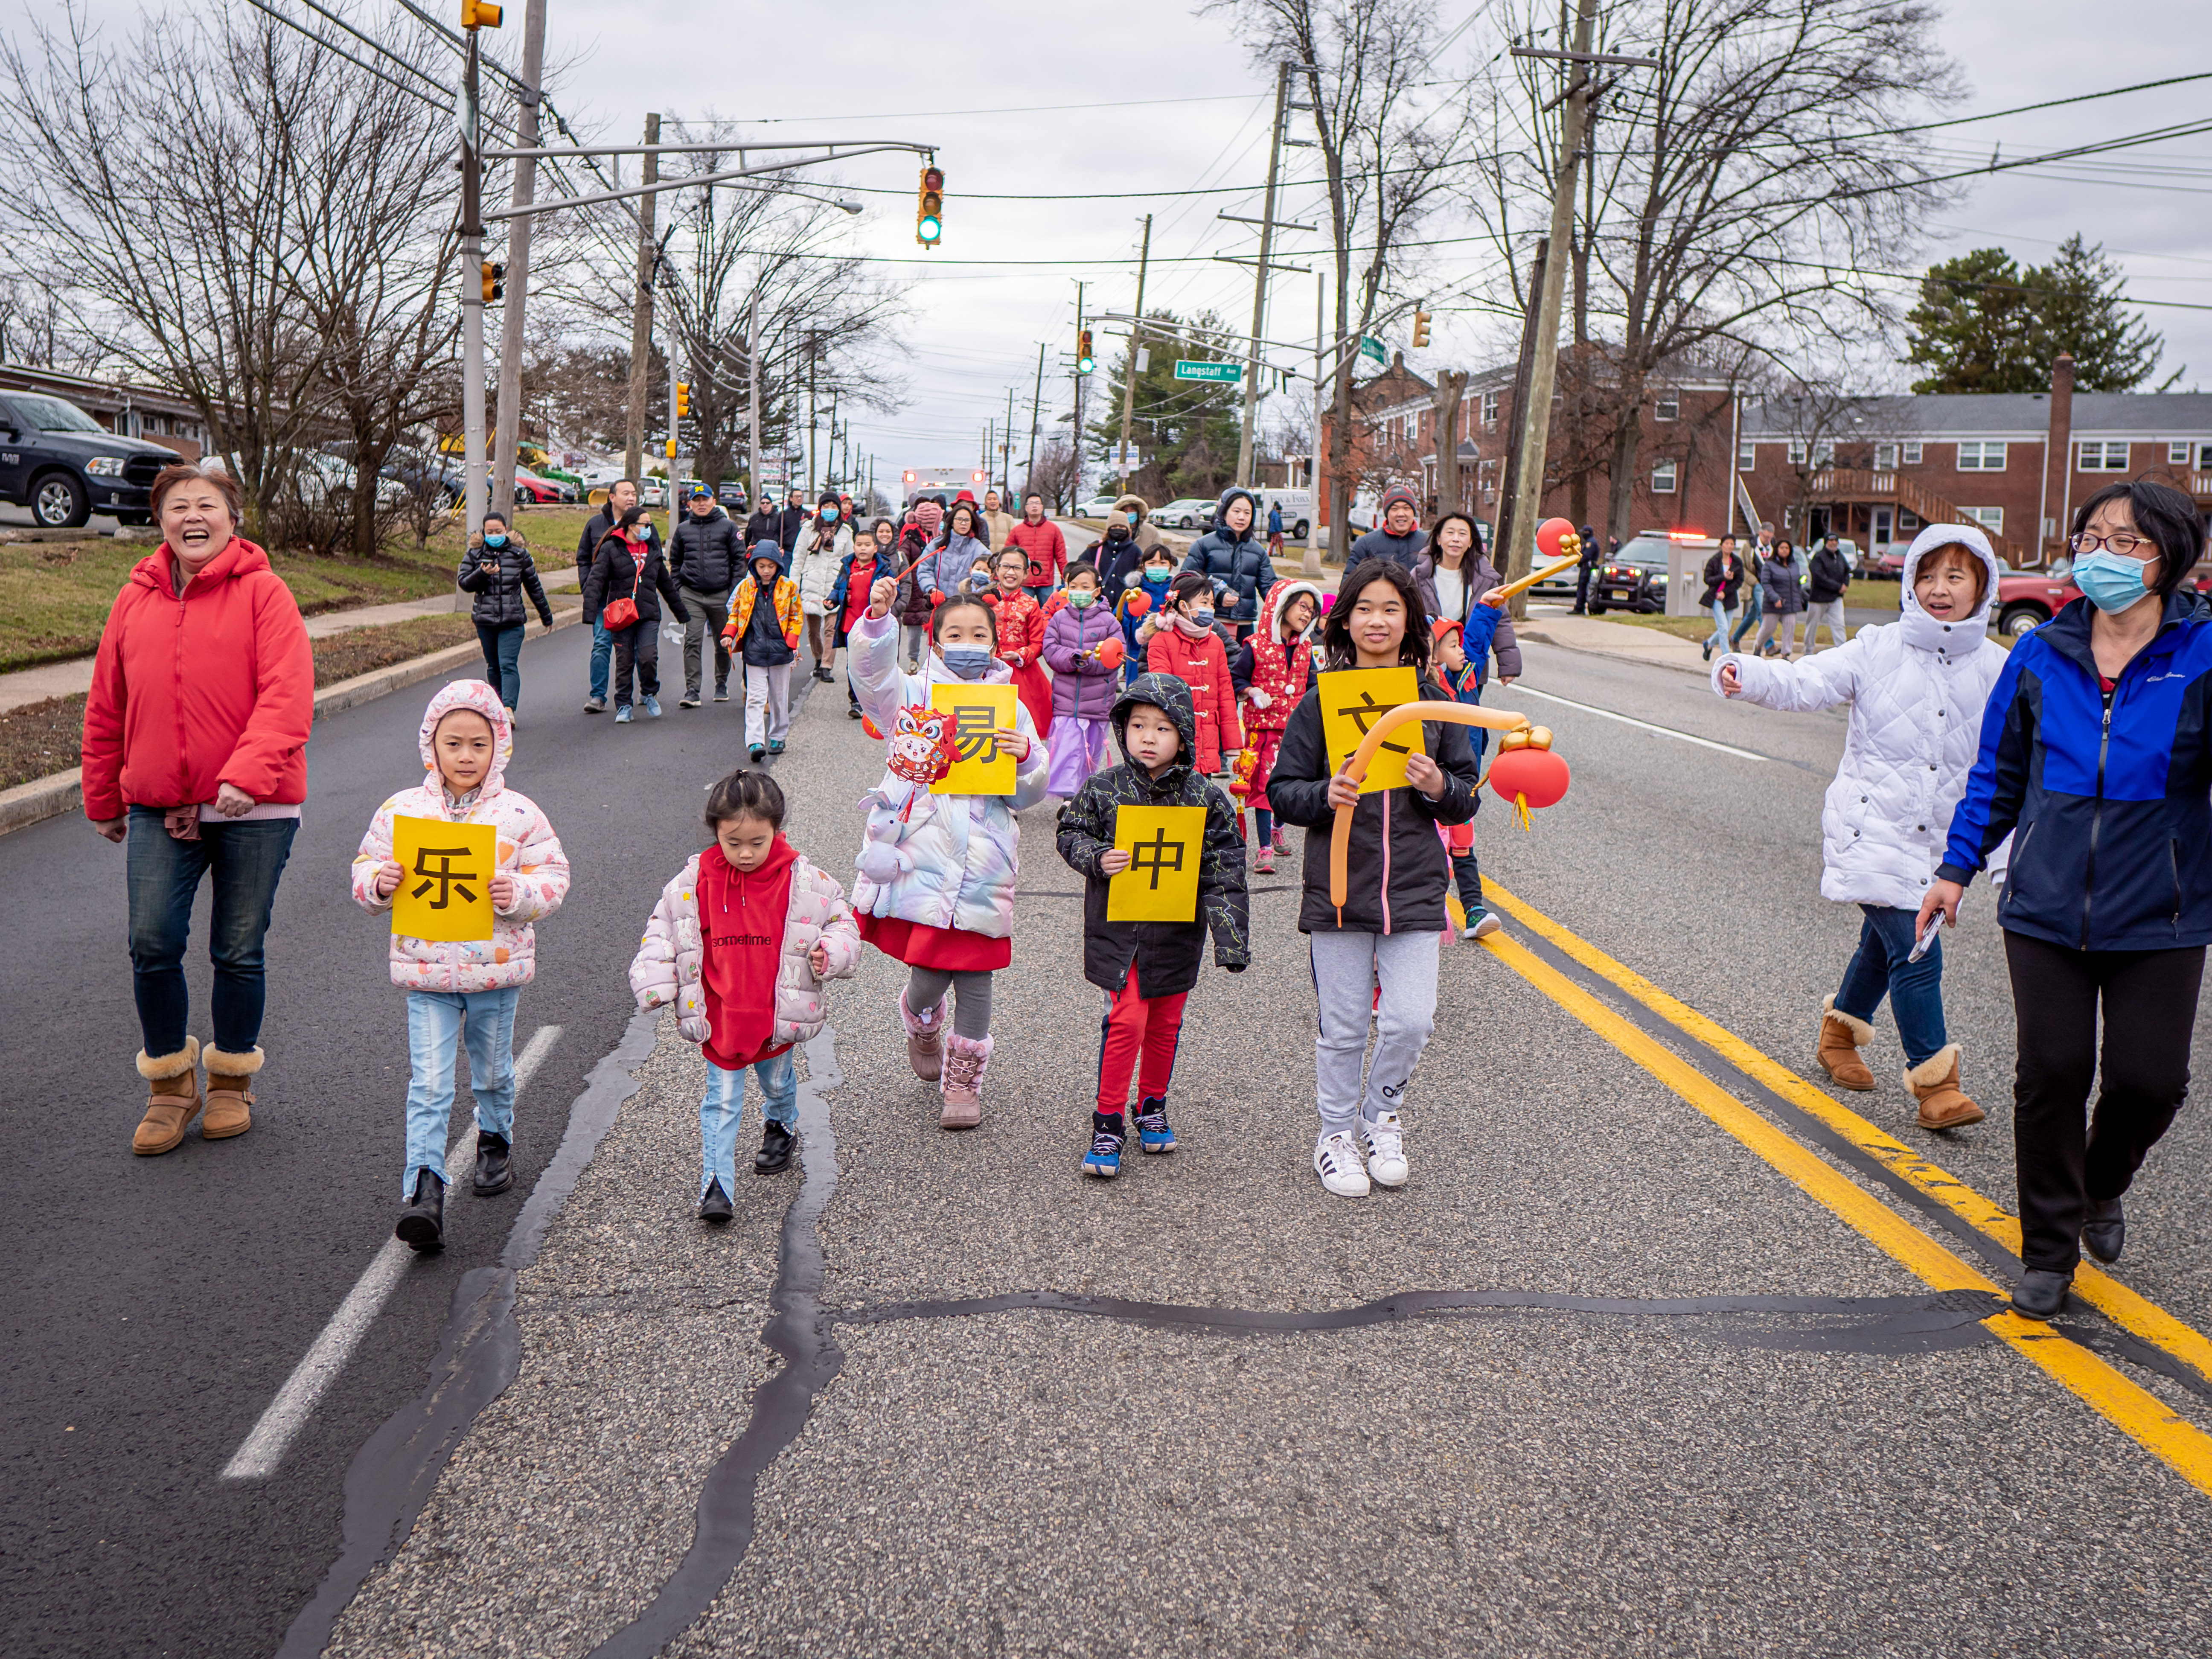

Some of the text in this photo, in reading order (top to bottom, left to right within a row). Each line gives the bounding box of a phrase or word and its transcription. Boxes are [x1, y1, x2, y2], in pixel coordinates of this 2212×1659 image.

[1181, 364, 1221, 378] Langstaff
[954, 706, 999, 764] 易
[1338, 691, 1410, 759] 文
[411, 847, 477, 910] 乐
[1131, 828, 1185, 890] 中
[712, 933, 771, 947] sometime
